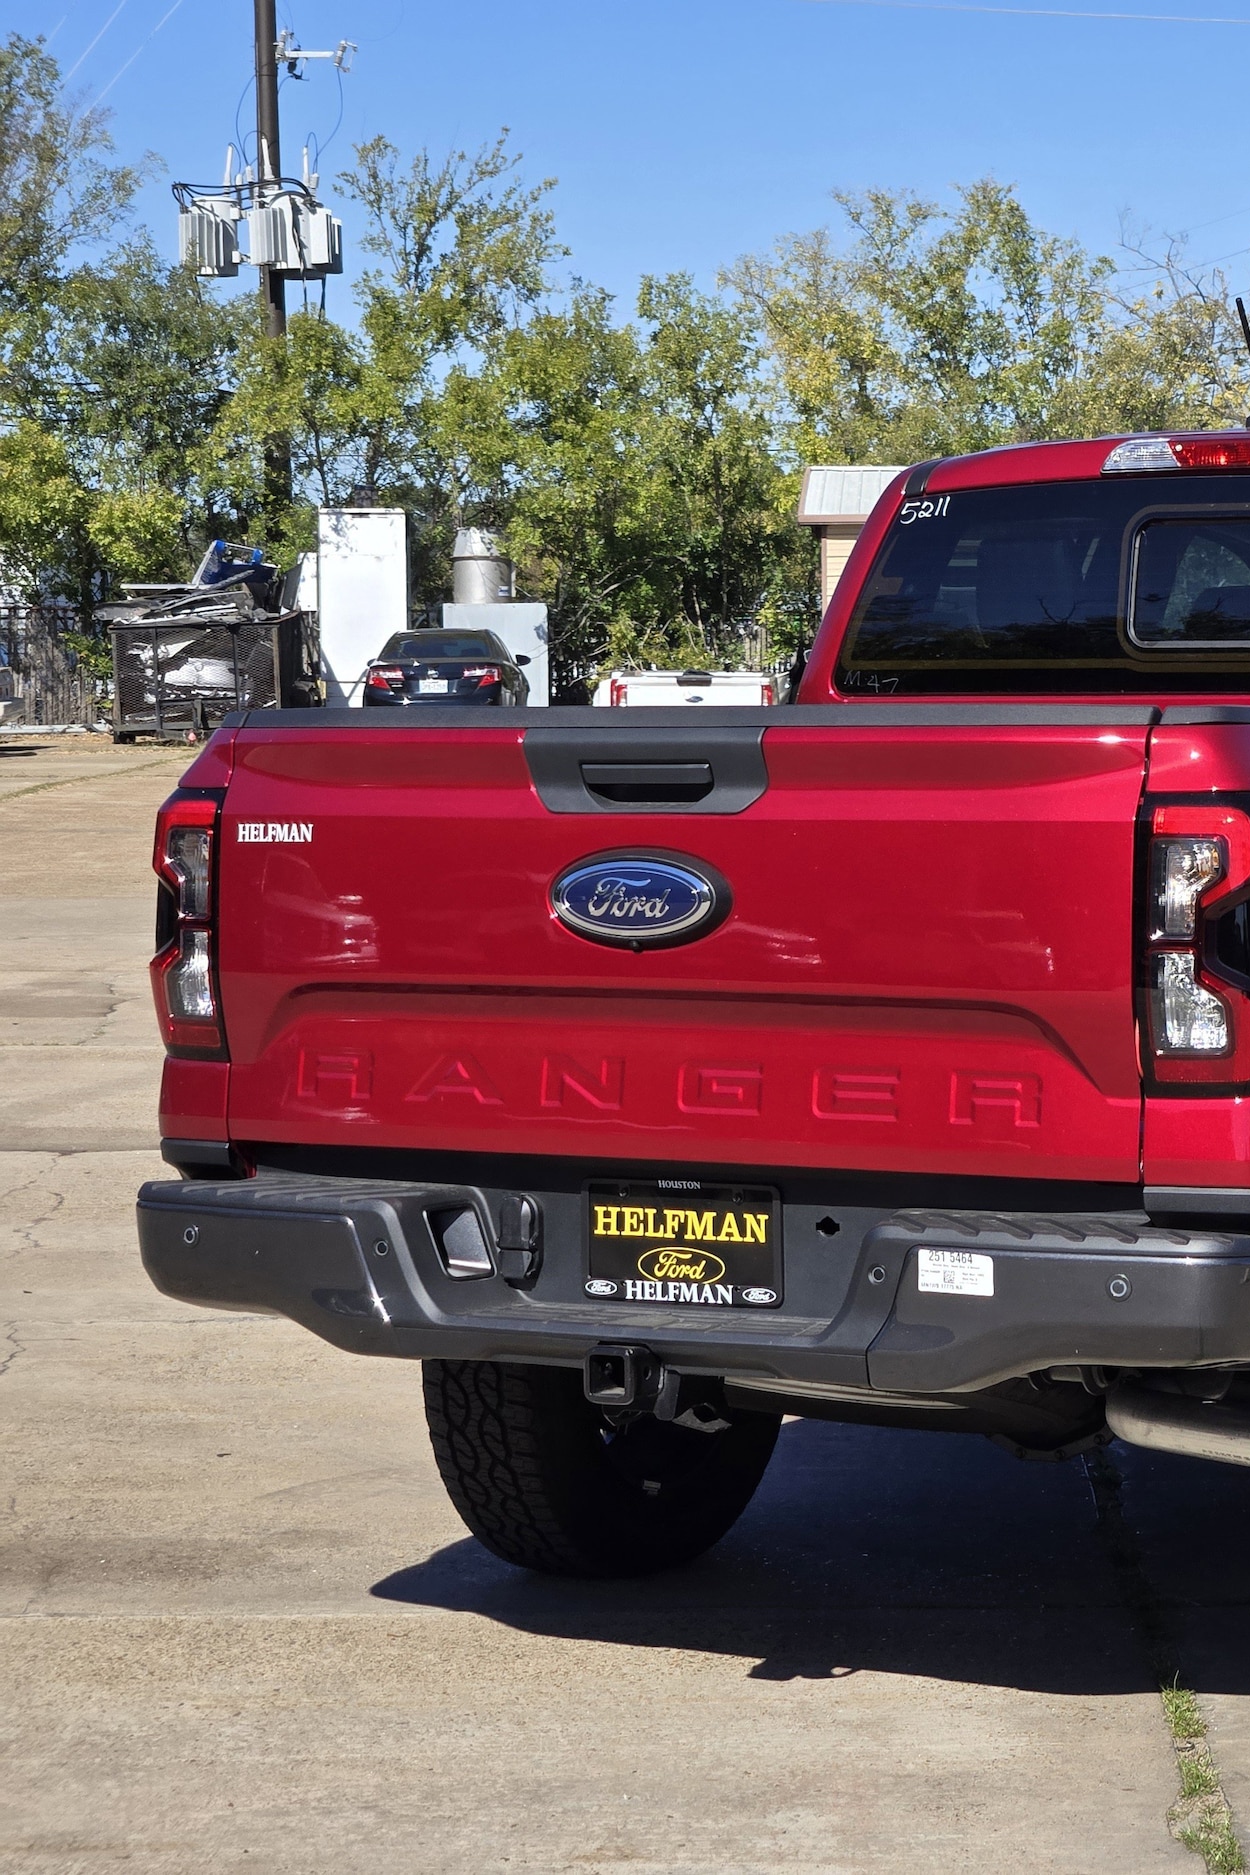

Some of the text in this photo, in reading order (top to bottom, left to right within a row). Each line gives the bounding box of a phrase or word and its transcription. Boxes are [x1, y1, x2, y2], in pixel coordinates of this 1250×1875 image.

[900, 496, 950, 524] 5211
[237, 823, 314, 842] HELFMAN
[588, 877, 672, 919] Ford
[297, 1047, 1043, 1128] RANGER
[658, 1180, 701, 1190] HOUSTON
[594, 1205, 769, 1244] HELFMAN
[654, 1251, 706, 1280] Ford
[625, 1279, 734, 1305] HELFMAN
